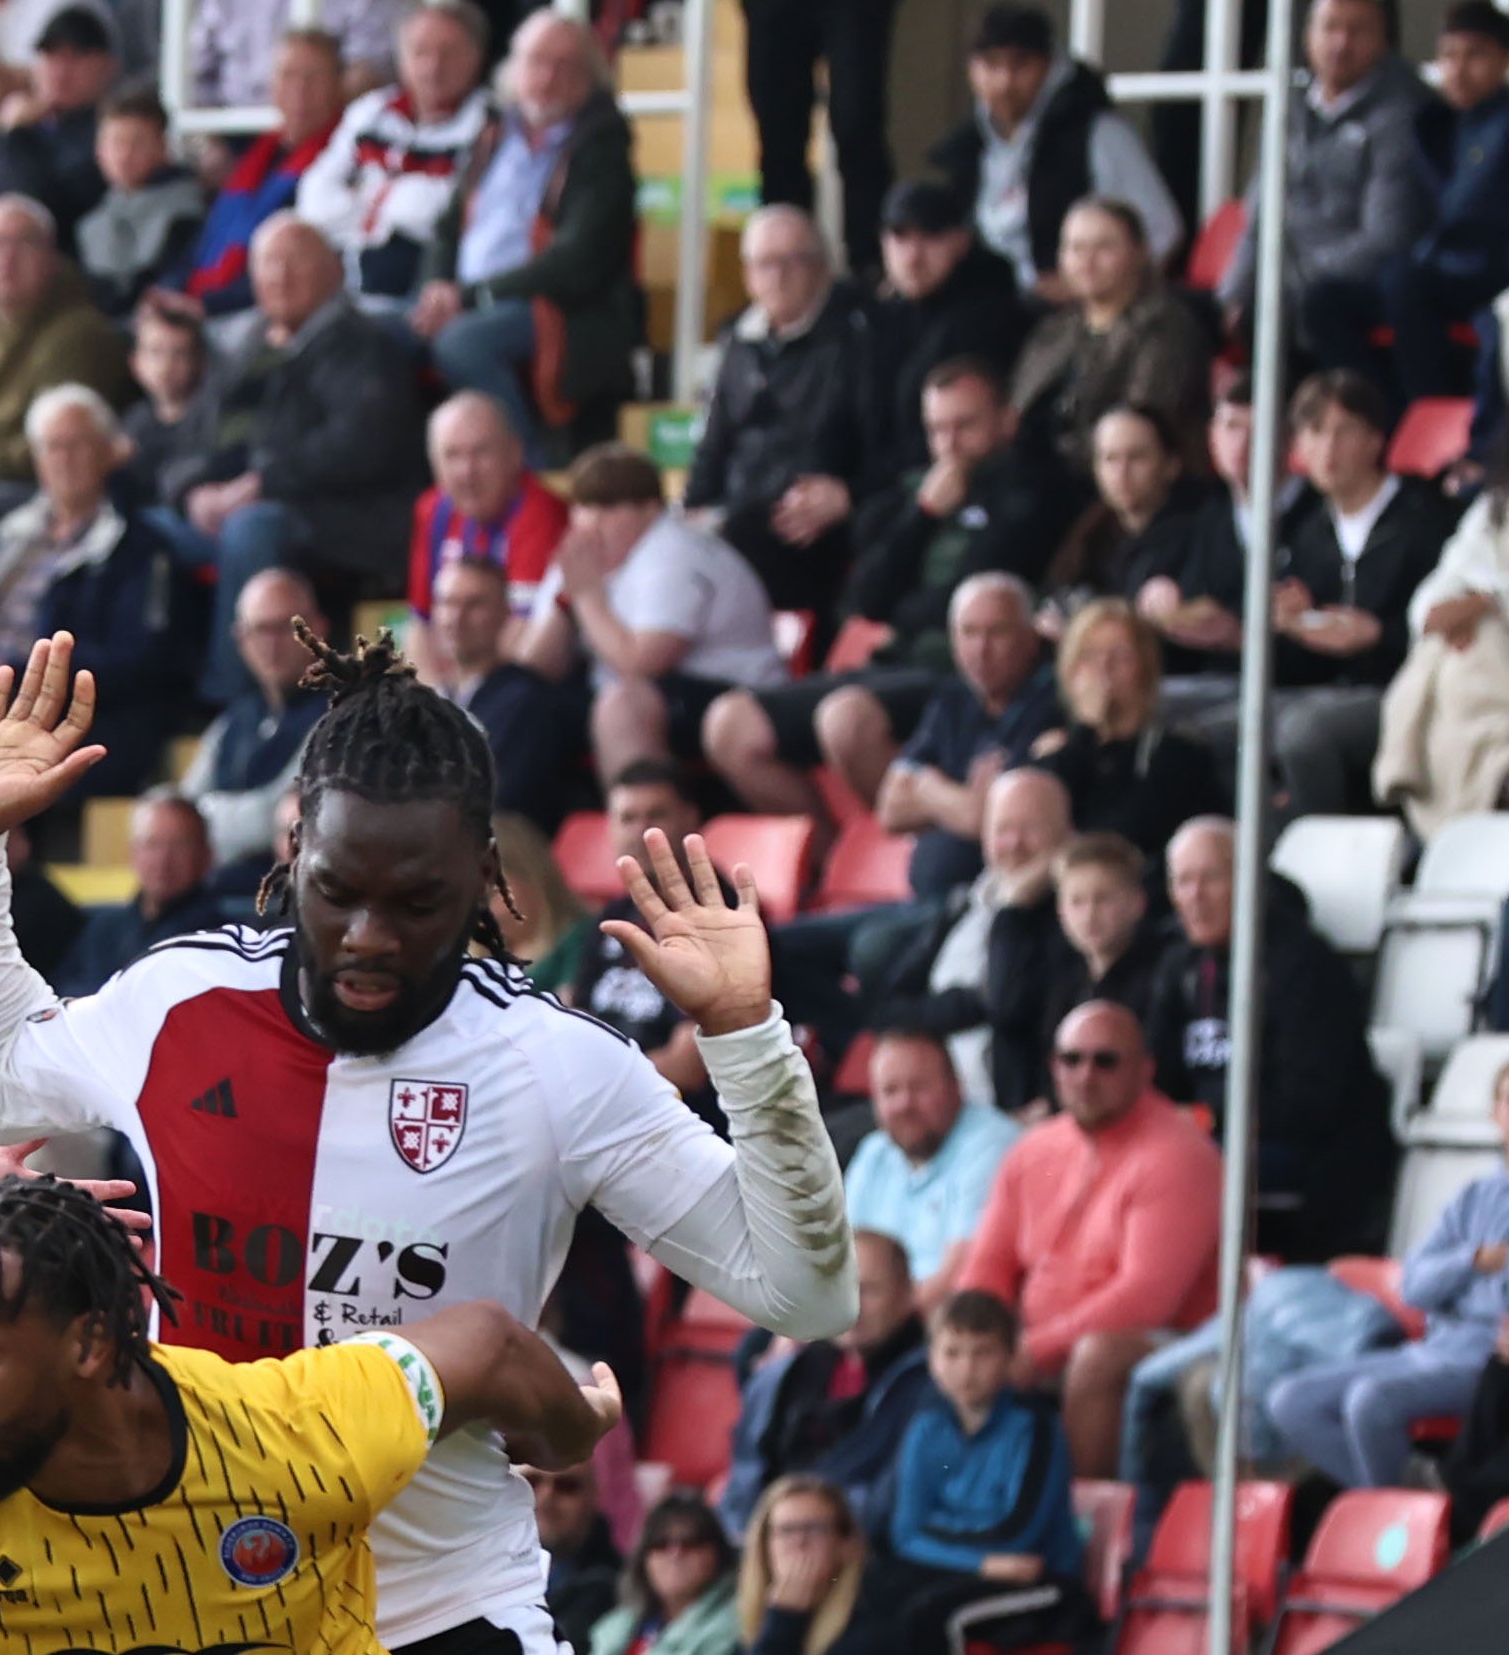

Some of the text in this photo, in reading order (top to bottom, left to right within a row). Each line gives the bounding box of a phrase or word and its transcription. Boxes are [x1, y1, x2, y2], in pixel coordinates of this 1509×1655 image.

[191, 1210, 449, 1300] BOZ'S
[313, 1300, 403, 1326] & Retail
